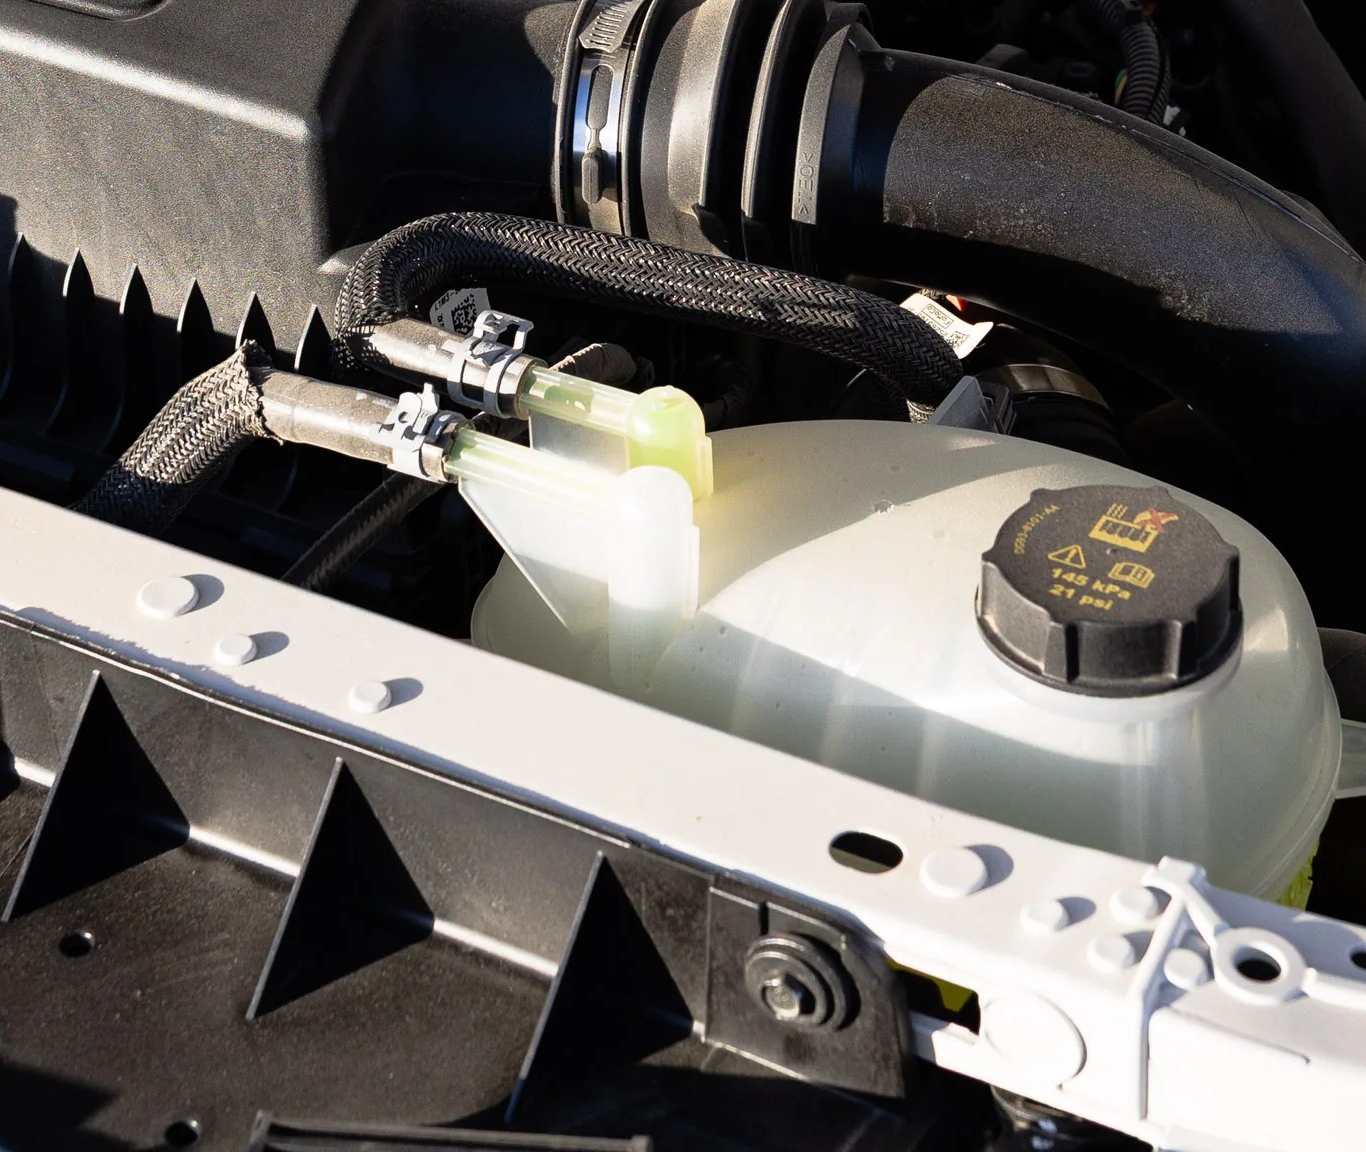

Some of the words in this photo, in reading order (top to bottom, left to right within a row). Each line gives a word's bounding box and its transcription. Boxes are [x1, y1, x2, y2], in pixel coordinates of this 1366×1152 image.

[1049, 584, 1076, 599] 21
[1078, 594, 1114, 611] psi
[1051, 568, 1089, 586] 145
[1092, 580, 1132, 600] kPa
